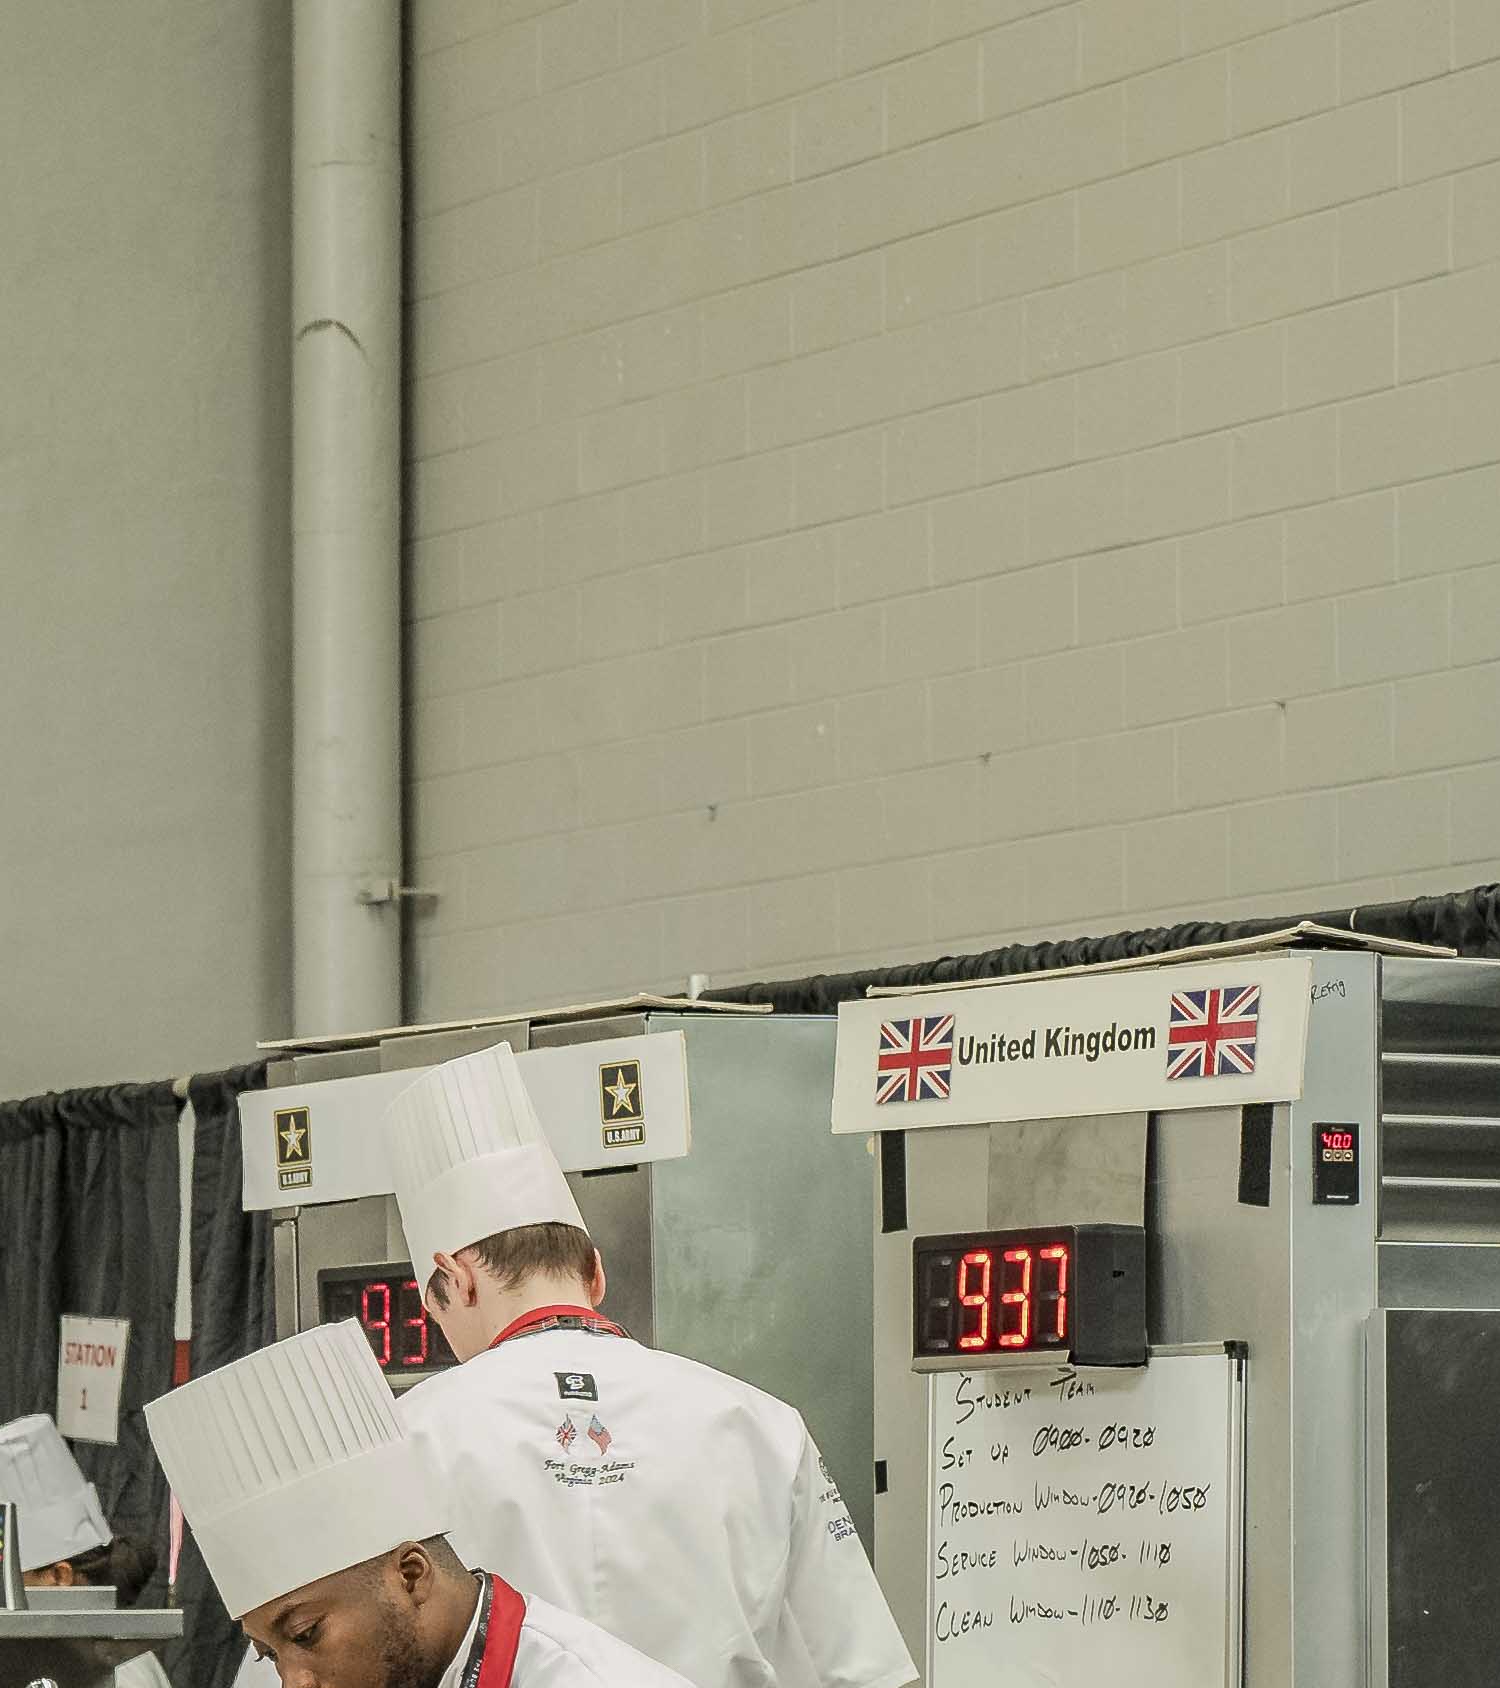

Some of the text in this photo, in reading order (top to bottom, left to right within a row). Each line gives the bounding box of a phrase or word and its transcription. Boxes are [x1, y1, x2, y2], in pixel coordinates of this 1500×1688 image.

[958, 1022, 1157, 1066] United Kingdom
[957, 1242, 1069, 1350] 937
[65, 1342, 116, 1368] STATION
[80, 1388, 87, 1410] 1
